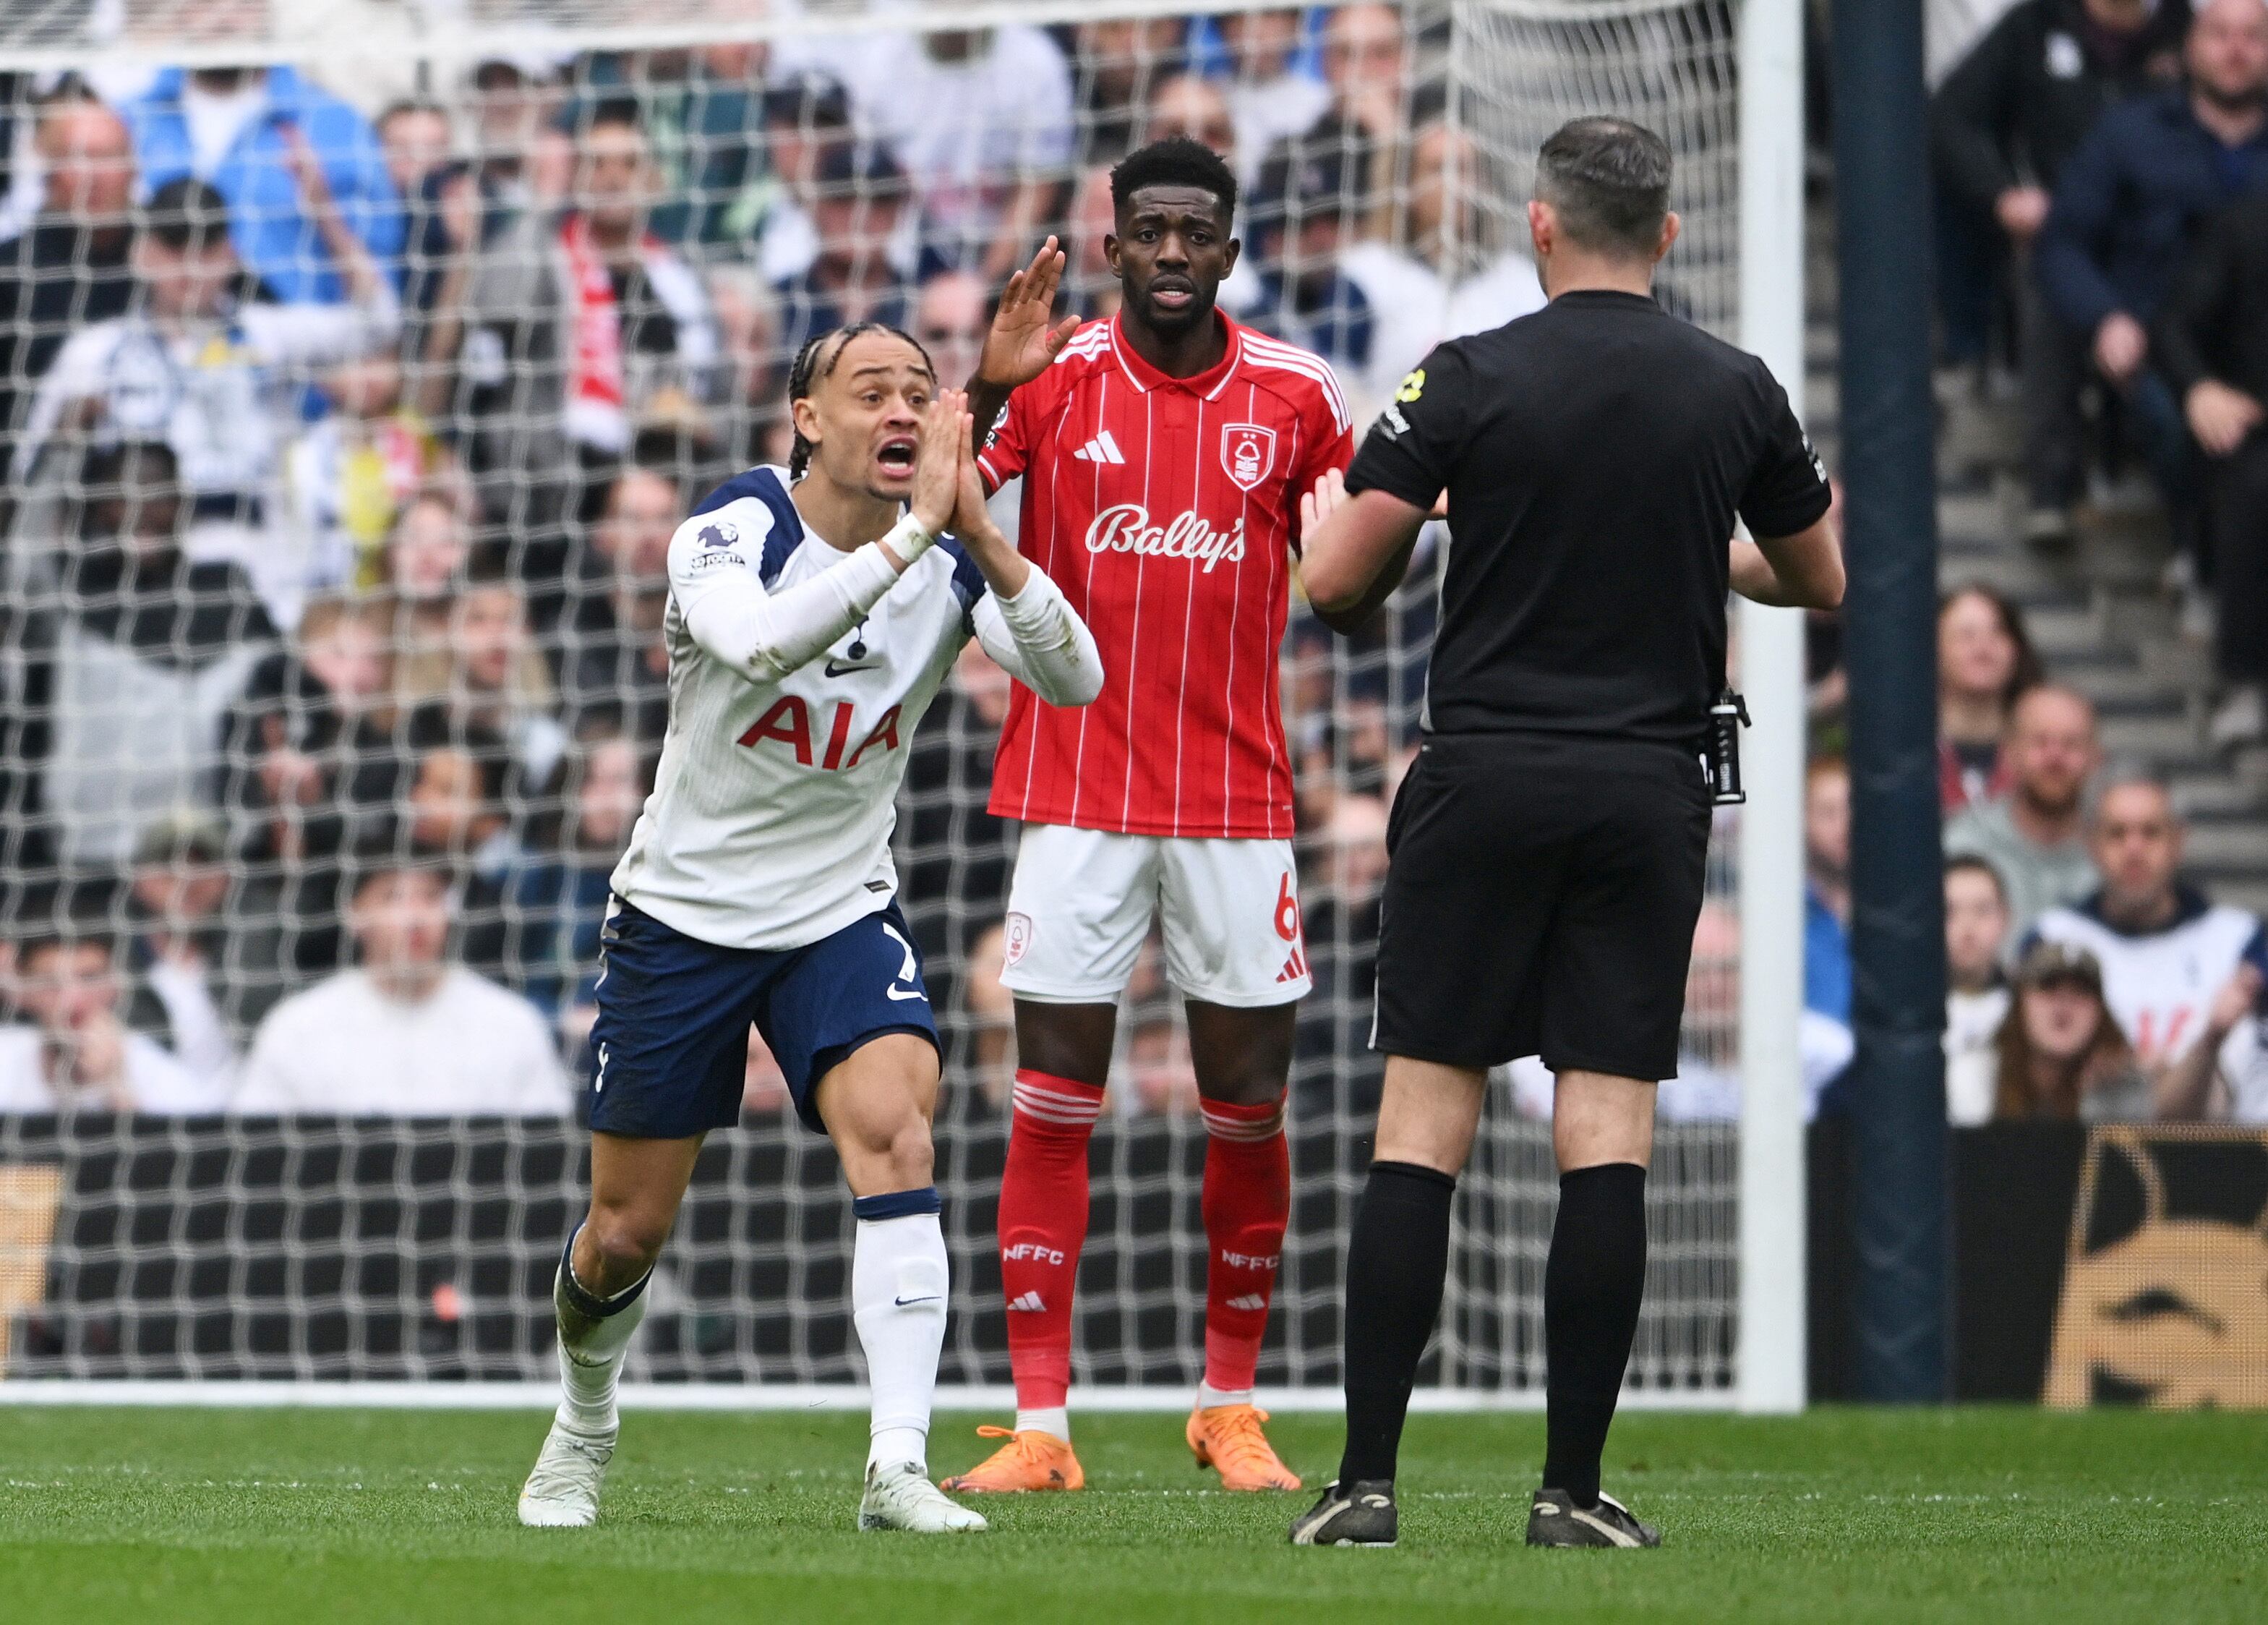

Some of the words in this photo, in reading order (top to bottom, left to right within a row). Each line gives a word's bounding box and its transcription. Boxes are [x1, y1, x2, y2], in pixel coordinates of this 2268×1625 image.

[1085, 503, 1245, 573] Bally's
[737, 695, 902, 770] AIA
[1275, 871, 1298, 942] 6
[882, 921, 917, 984] 7
[1003, 1243, 1064, 1266] NFFC
[1221, 1249, 1280, 1271] NFFC
